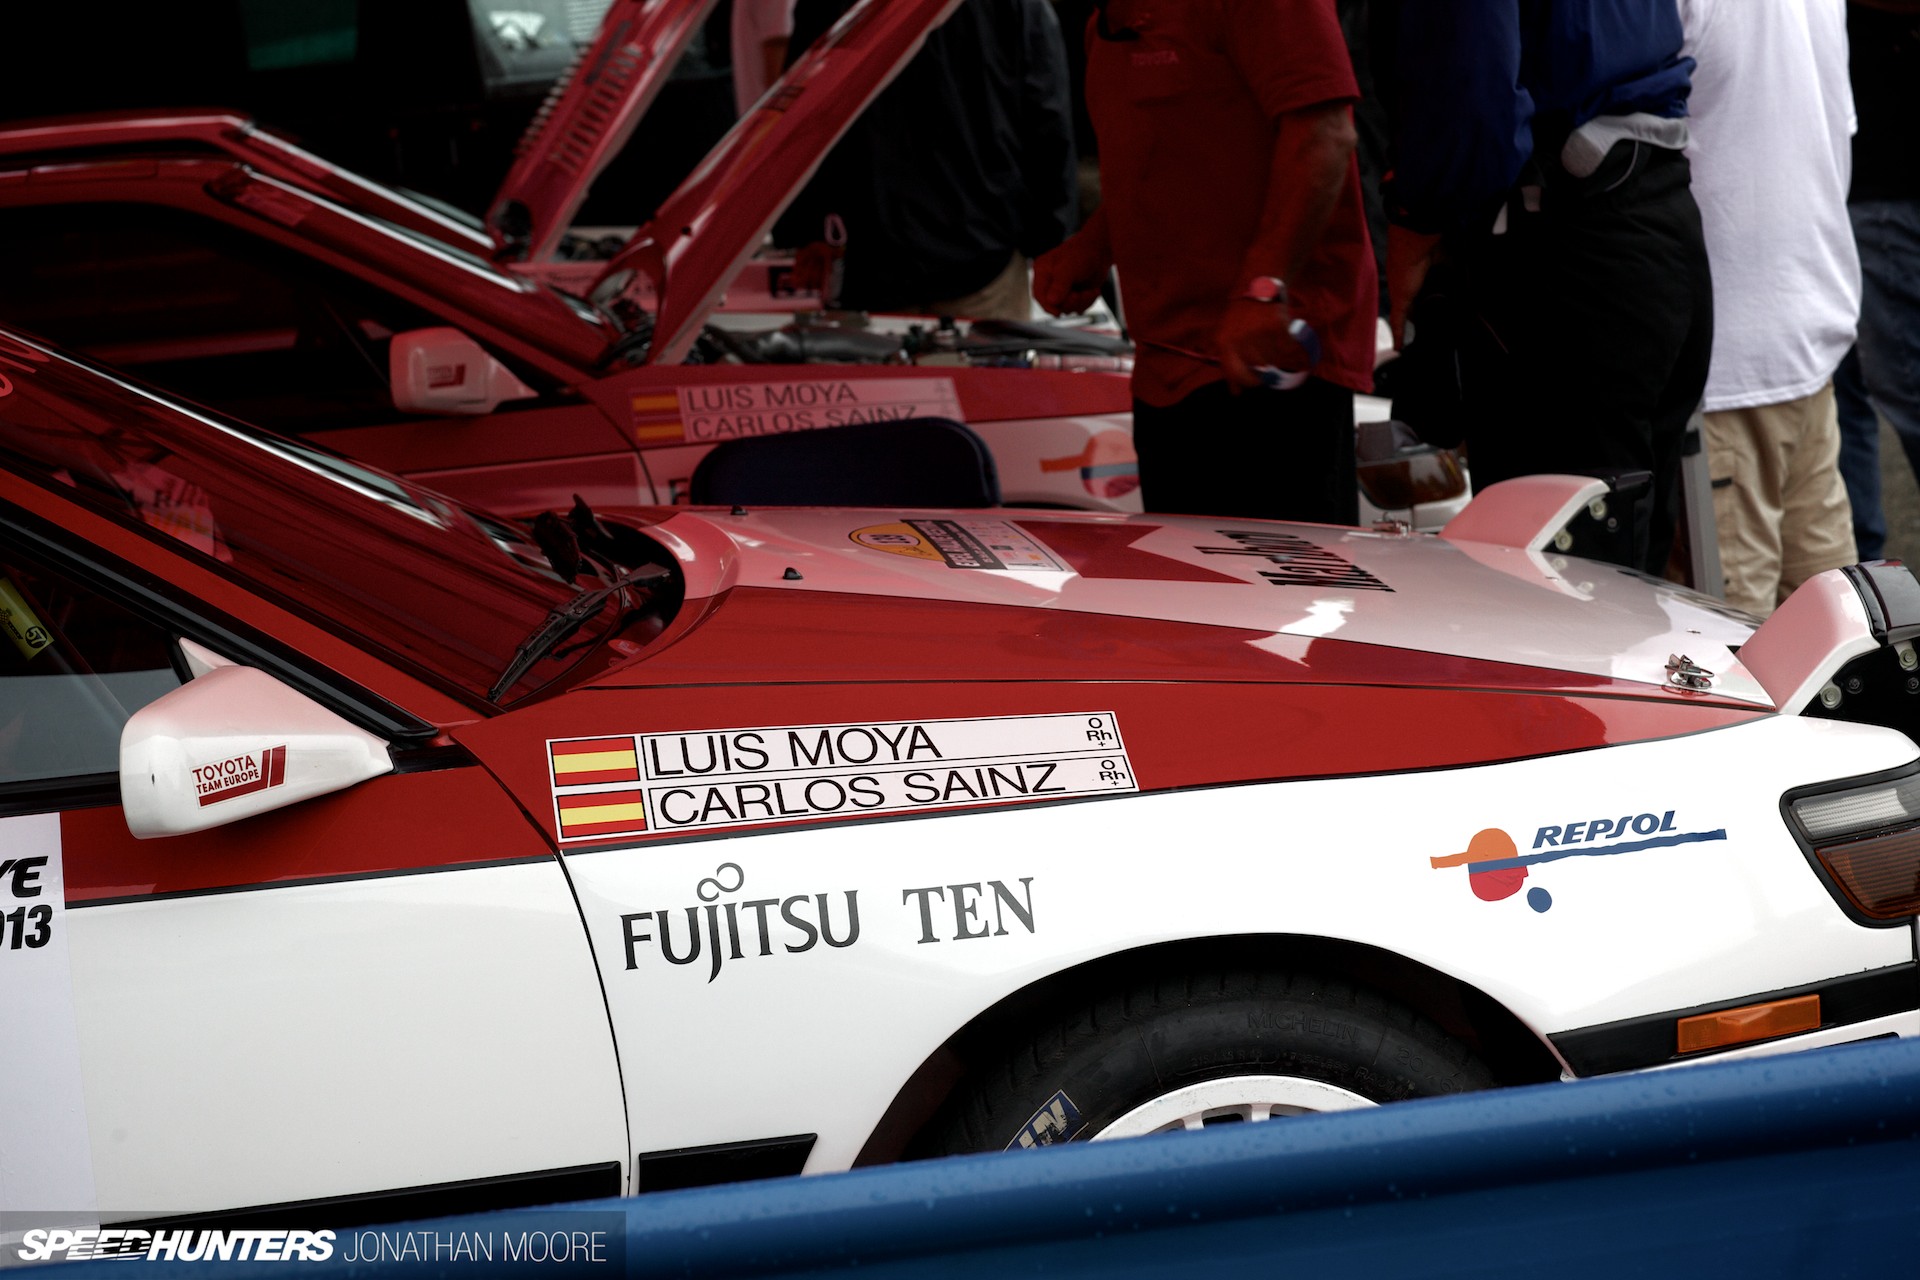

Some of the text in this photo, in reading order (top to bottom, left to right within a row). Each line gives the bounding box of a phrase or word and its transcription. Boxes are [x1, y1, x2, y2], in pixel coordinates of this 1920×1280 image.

[688, 381, 859, 414] LUIS MOYA
[692, 411, 815, 441] CARLOS
[650, 725, 943, 776] LUIS MOYA
[1086, 729, 1113, 742] Rh
[192, 755, 257, 783] TOYOTA
[196, 768, 260, 795] TEAM EUROPE
[1098, 770, 1126, 781] Rh
[660, 762, 1066, 826] CARLOS SAINZ
[1532, 810, 1677, 849] REPSOL
[0, 904, 53, 951] 13
[619, 863, 1036, 984] FUJITSU TEN
[1247, 1011, 1358, 1043] MICHELIN
